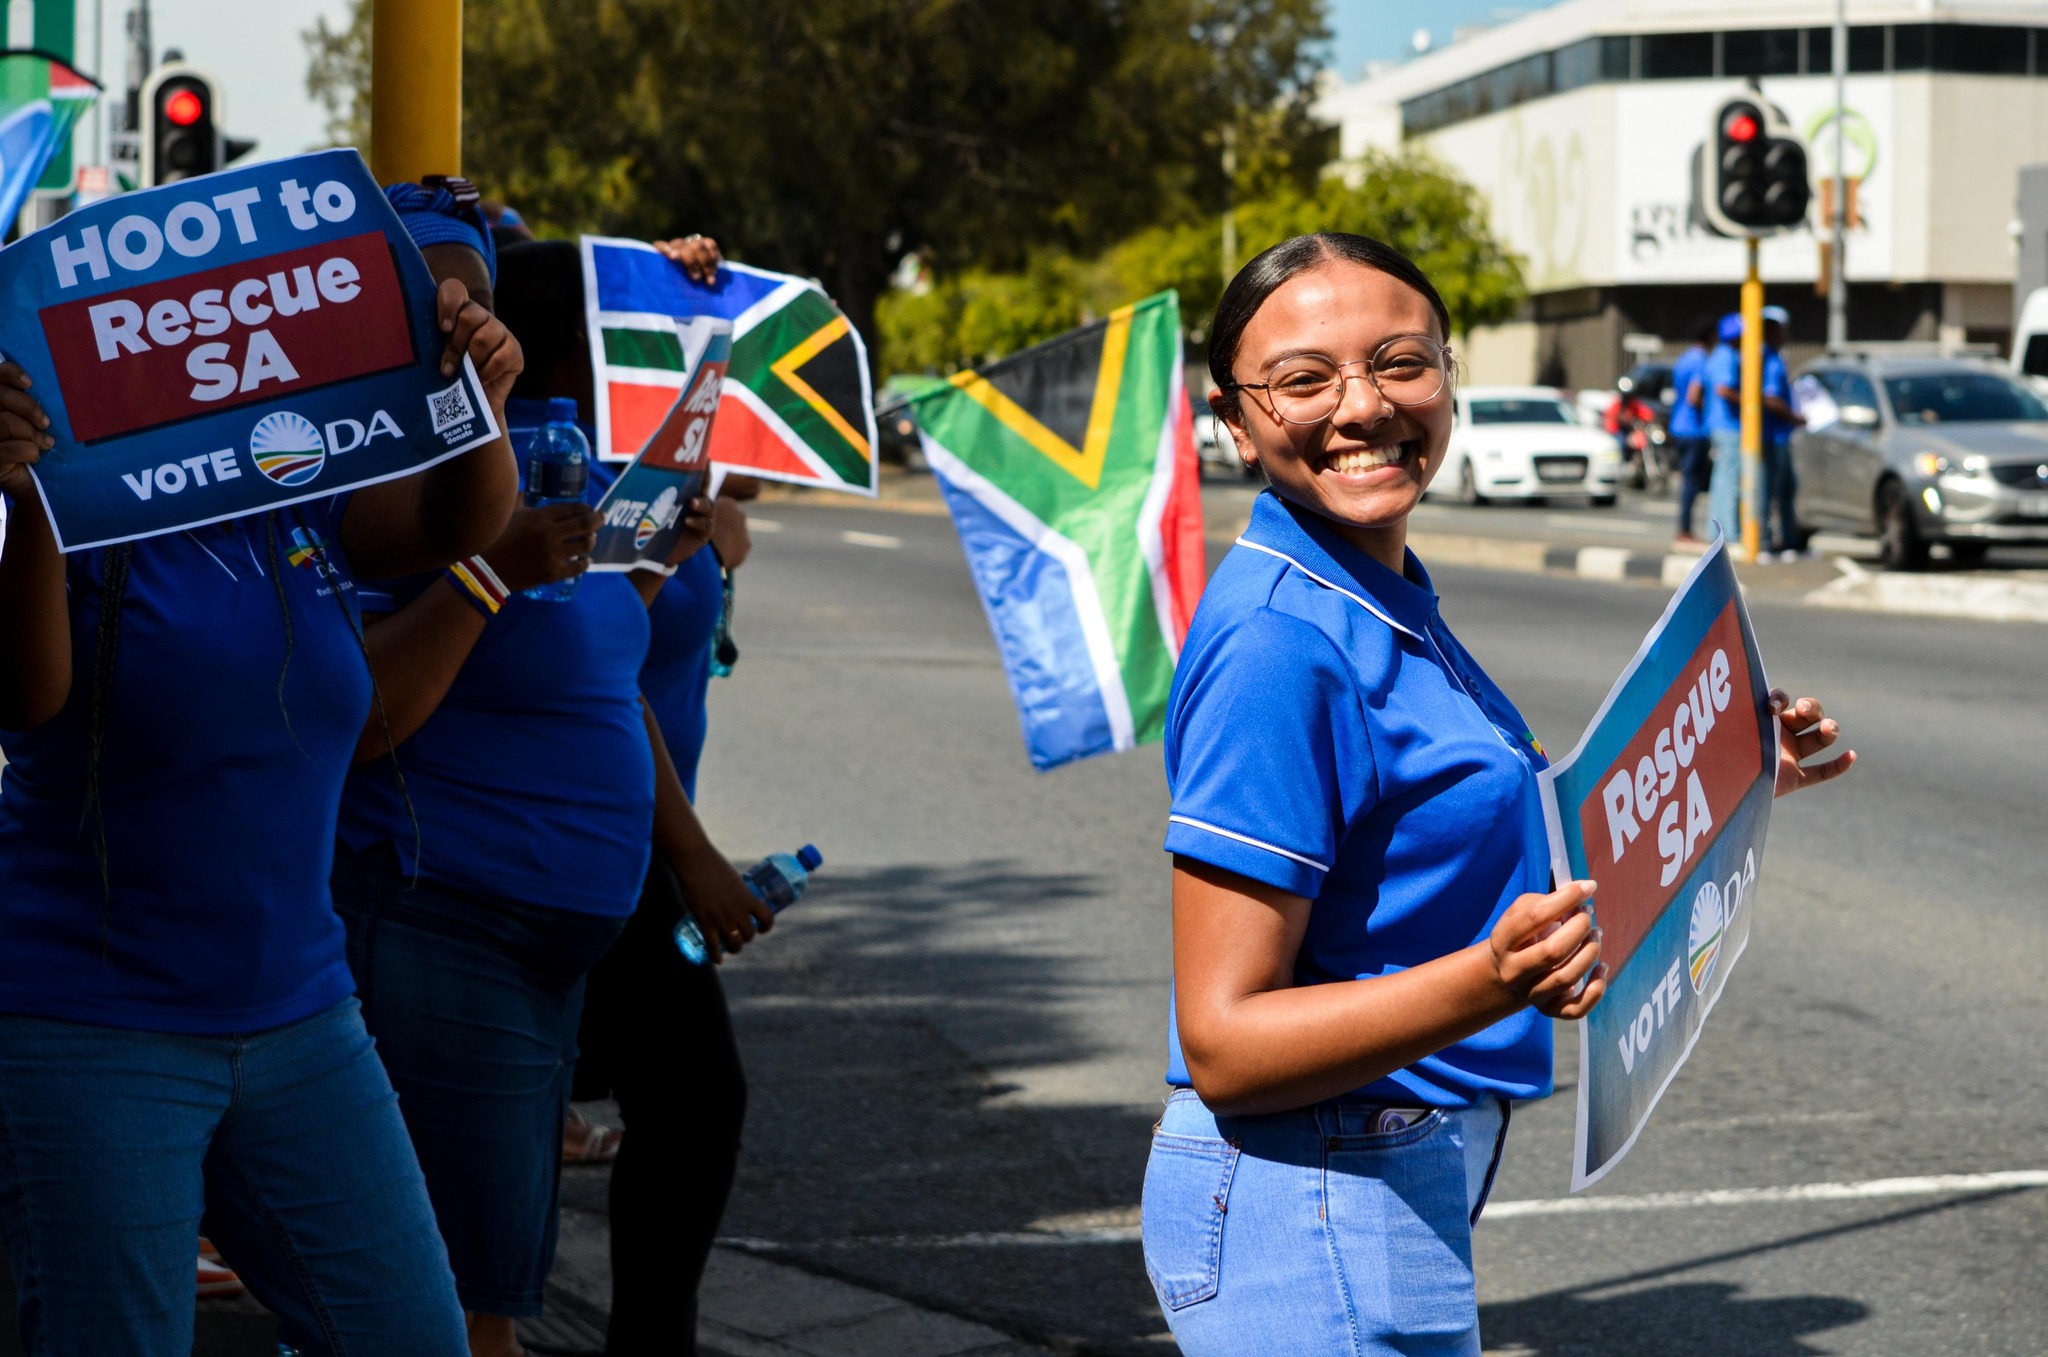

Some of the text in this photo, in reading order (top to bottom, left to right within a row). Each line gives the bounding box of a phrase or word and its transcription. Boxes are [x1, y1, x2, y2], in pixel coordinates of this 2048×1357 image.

[50, 179, 357, 289] HOOT to
[88, 257, 361, 362] Rescue
[186, 329, 300, 401] SA
[122, 409, 405, 501] VOTE DA
[442, 423, 472, 439] Scan to
[446, 429, 474, 445] donate
[604, 499, 648, 528] VOTE
[316, 562, 340, 578] DA
[1602, 648, 1732, 865] Rescue
[1657, 768, 1713, 888] SA
[1618, 847, 1756, 1076] VOTE DA
